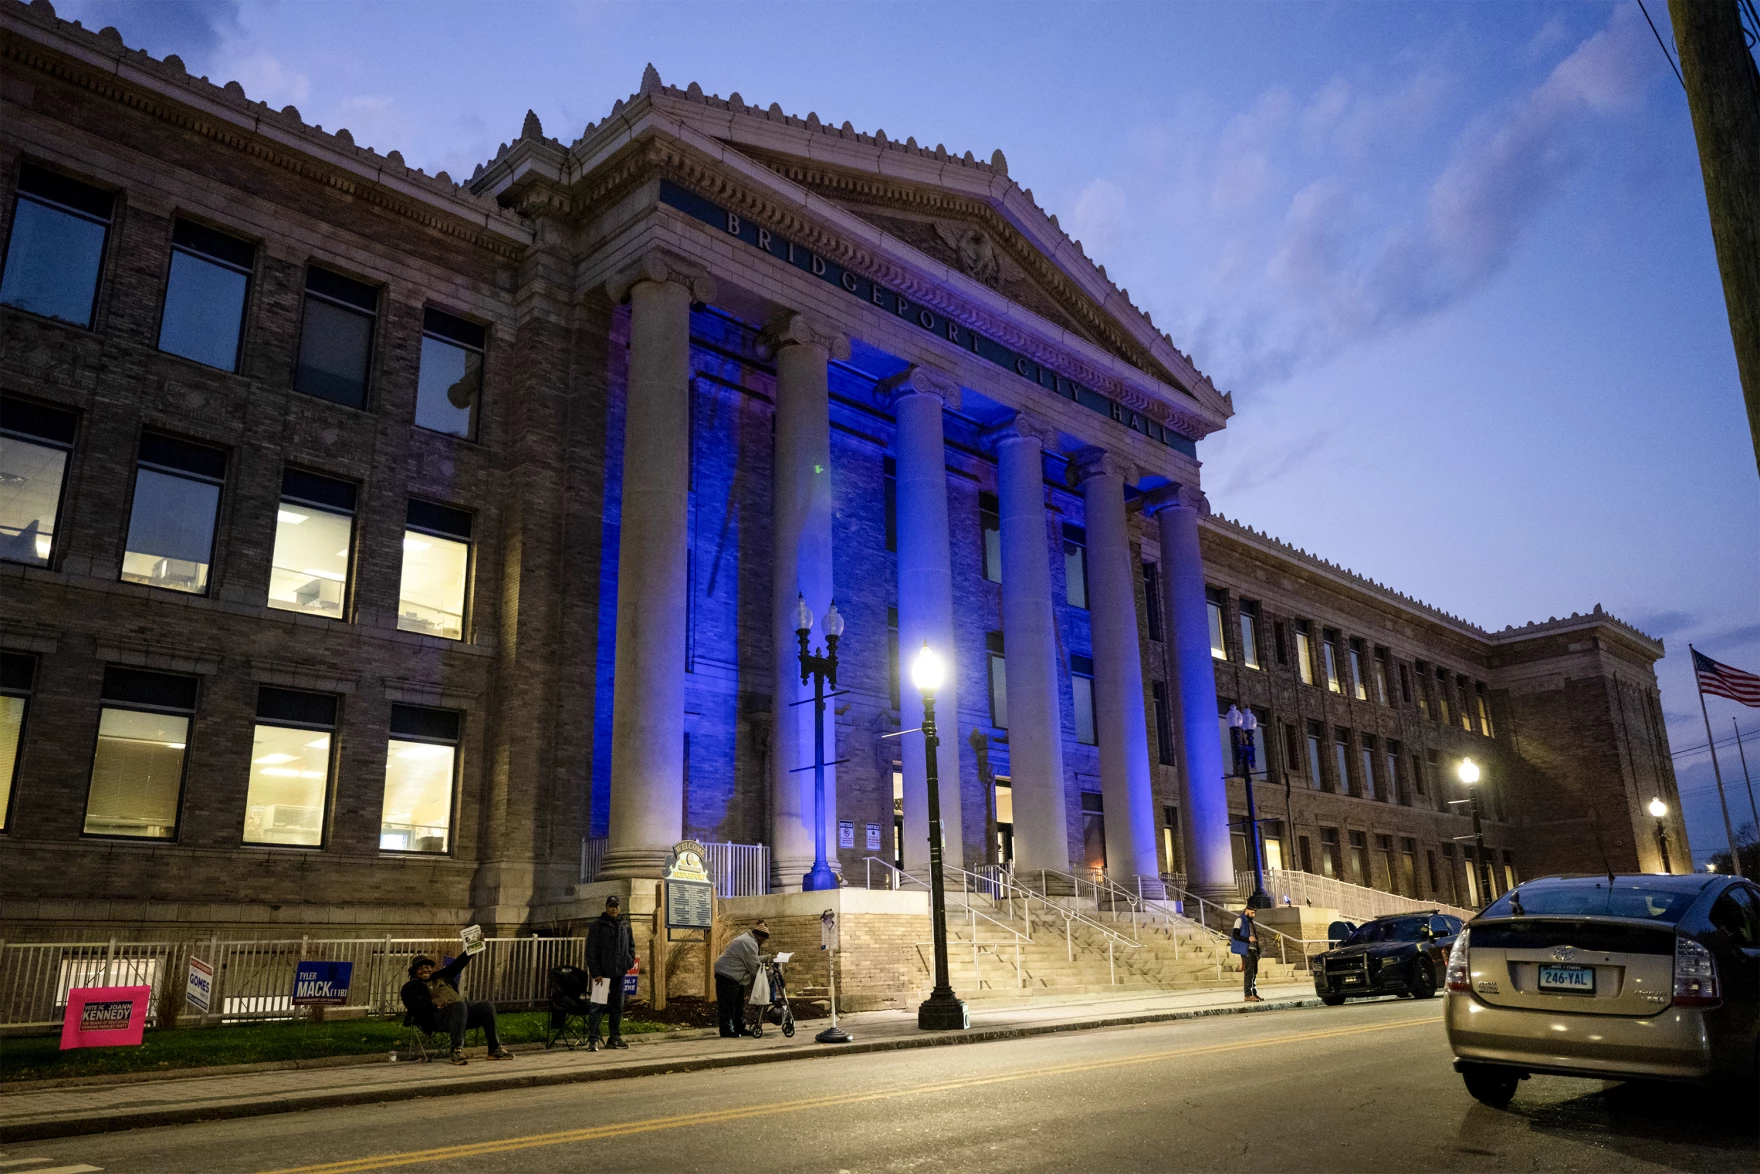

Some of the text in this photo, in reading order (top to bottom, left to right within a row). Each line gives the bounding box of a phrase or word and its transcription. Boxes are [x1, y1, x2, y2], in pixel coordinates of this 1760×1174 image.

[726, 212, 1171, 446] BRIDGEPORT CITY HALL
[675, 842, 706, 858] WELCOME
[189, 973, 210, 993] GOMES
[299, 972, 317, 980] TYLER
[296, 981, 332, 997] MACK
[82, 1010, 131, 1021] KENNEDY
